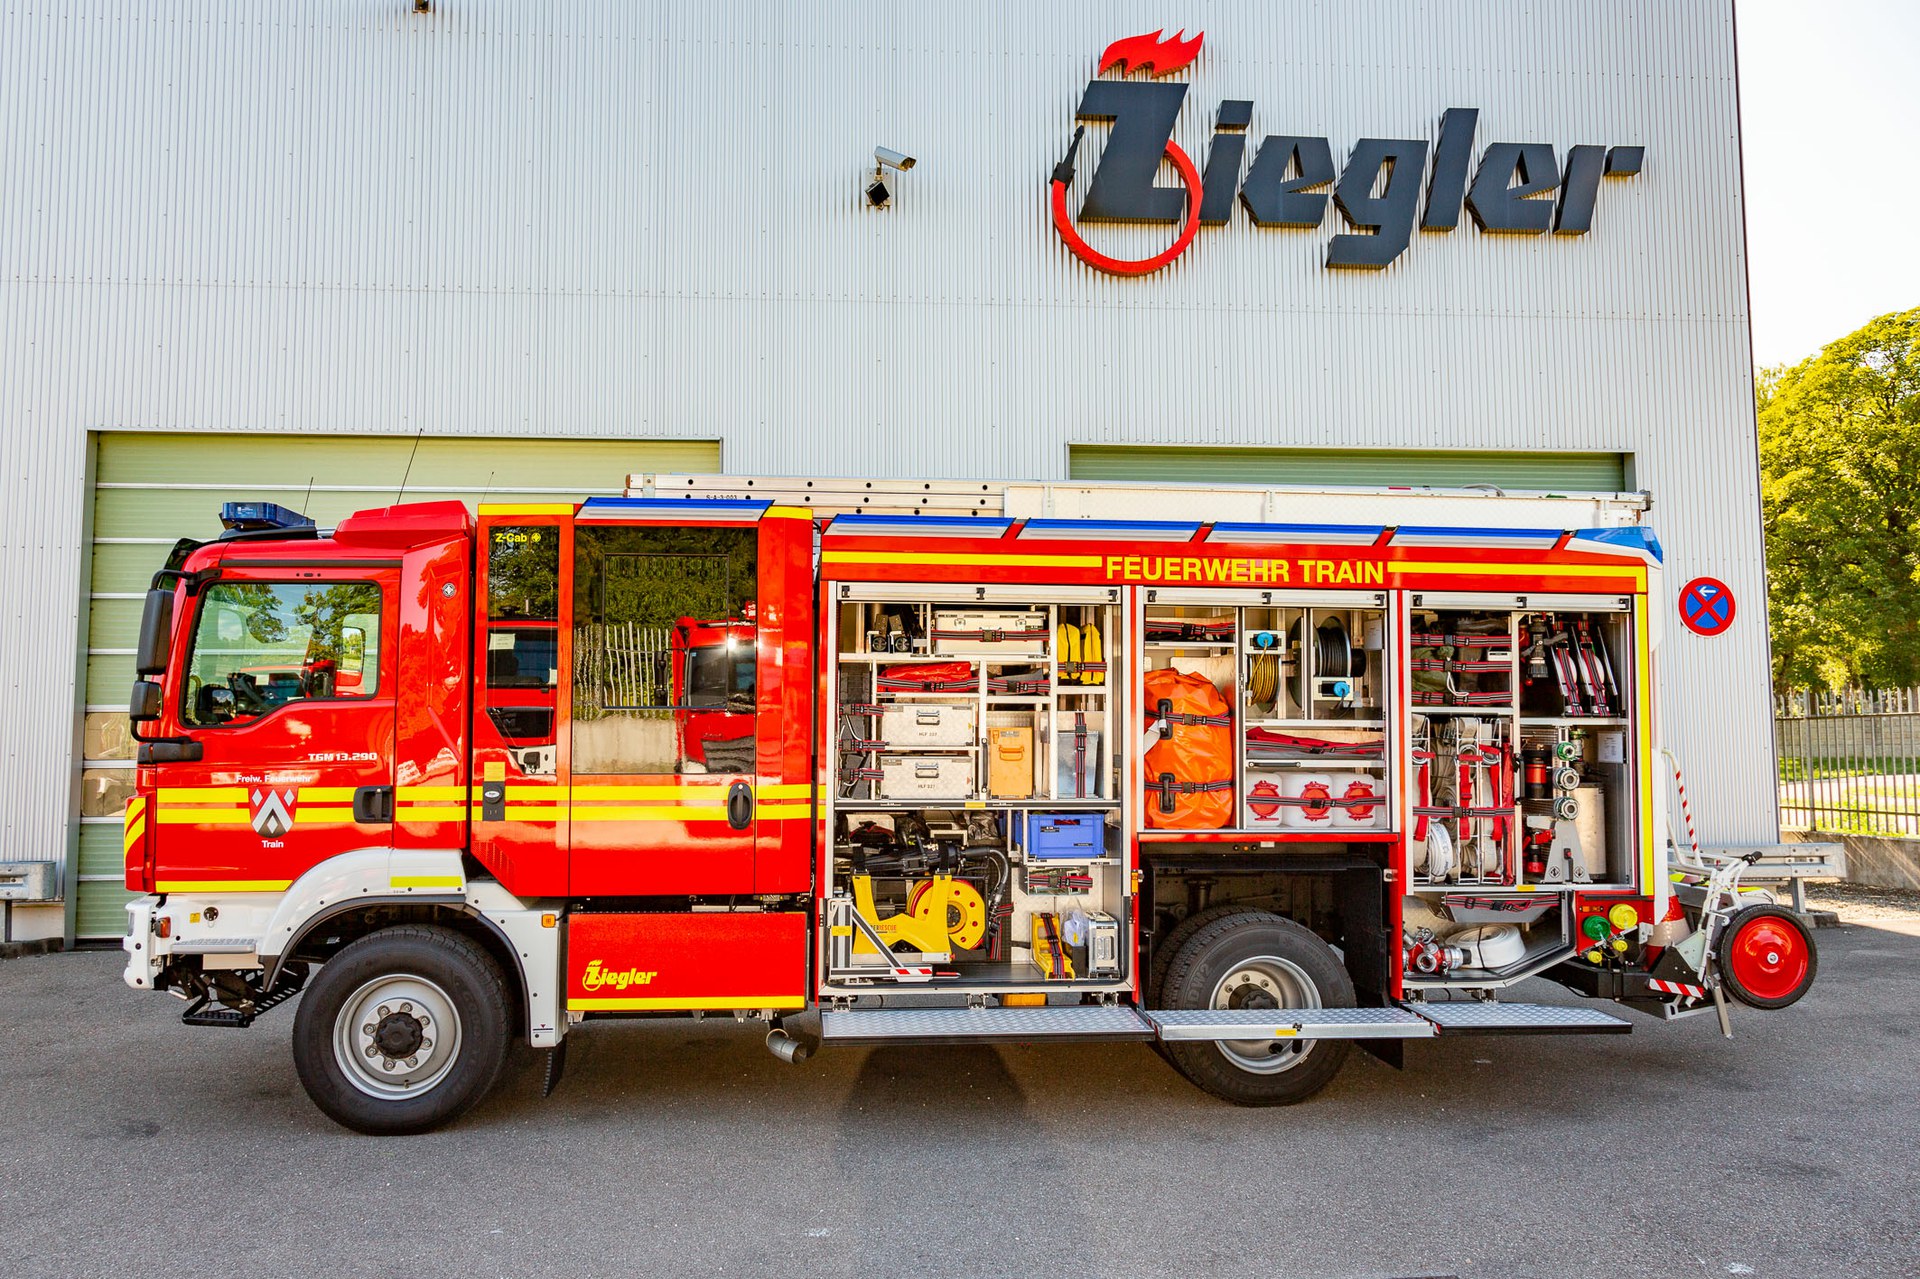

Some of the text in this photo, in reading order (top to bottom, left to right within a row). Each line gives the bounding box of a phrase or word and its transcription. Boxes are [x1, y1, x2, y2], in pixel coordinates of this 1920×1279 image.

[1060, 78, 1646, 272] Ziegler
[495, 532, 528, 543] Z-Cab
[1106, 556, 1384, 584] FEUERWEHR TRAIN
[307, 752, 378, 761] TGM 13.290
[236, 774, 312, 783] Freiw. Feuerwehr
[261, 840, 284, 848] Train
[583, 965, 658, 991] Ziegler
